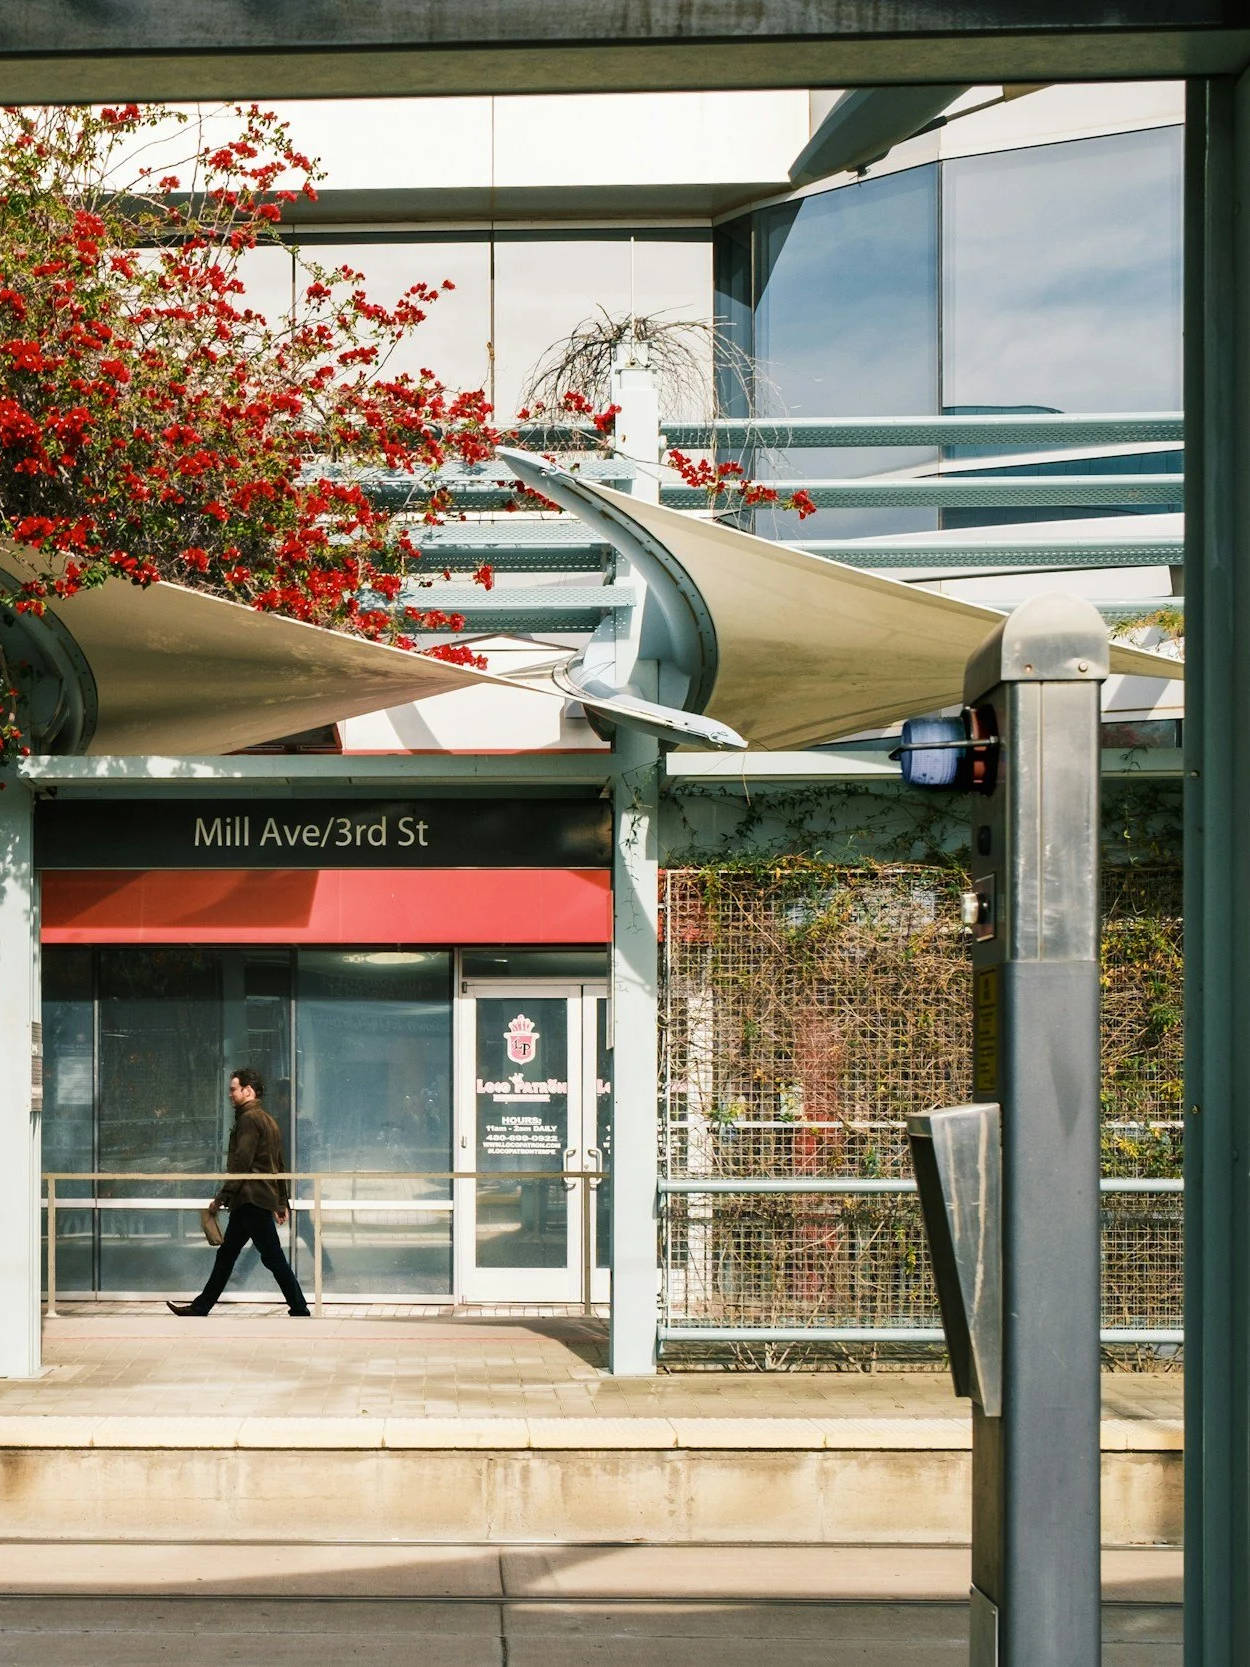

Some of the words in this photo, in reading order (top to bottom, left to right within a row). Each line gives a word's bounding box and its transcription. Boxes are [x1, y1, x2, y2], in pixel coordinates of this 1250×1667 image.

[194, 815, 250, 847] Mill
[259, 815, 388, 848] Ave/3rd
[398, 815, 429, 847] St
[501, 1116, 543, 1126] HOURS:
[485, 1124, 508, 1132] 11am
